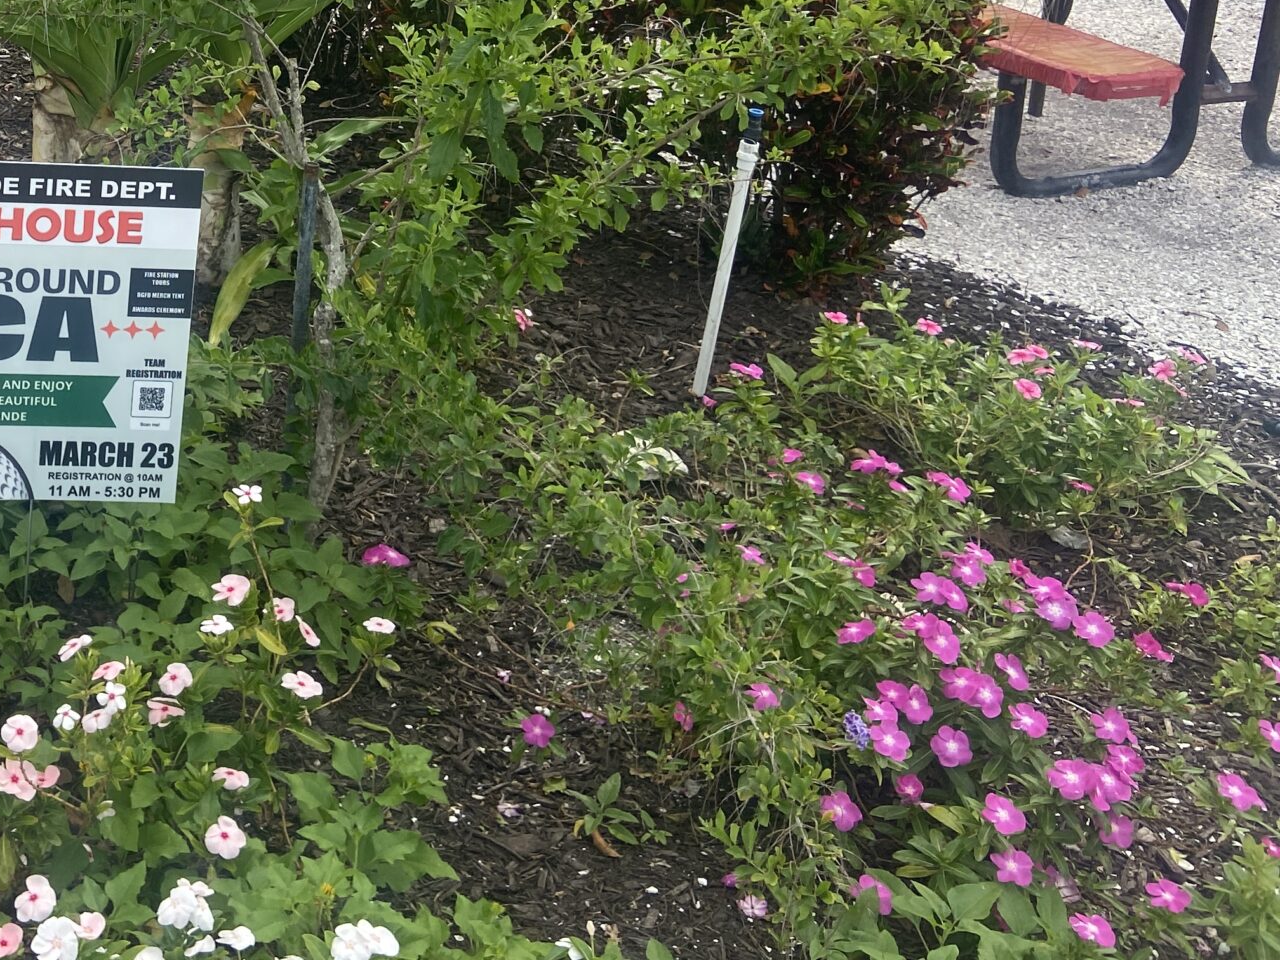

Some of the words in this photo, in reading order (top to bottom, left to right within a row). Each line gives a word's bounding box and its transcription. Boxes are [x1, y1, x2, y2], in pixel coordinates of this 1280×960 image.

[29, 178, 91, 198] FIRE
[100, 180, 176, 200] DEPT.
[144, 359, 166, 367] TEAM
[126, 369, 182, 379] REGISTRATION
[2, 380, 30, 390] AND
[34, 381, 73, 392] ENJOY
[39, 440, 135, 468] MARCH
[140, 442, 175, 469] 23
[48, 472, 121, 481] REGISTRATION
[124, 473, 134, 483] @
[137, 474, 163, 482] 10AM
[48, 485, 62, 496] 11
[67, 486, 91, 497] AM
[104, 486, 134, 498] 5:30
[138, 487, 160, 498] PM
